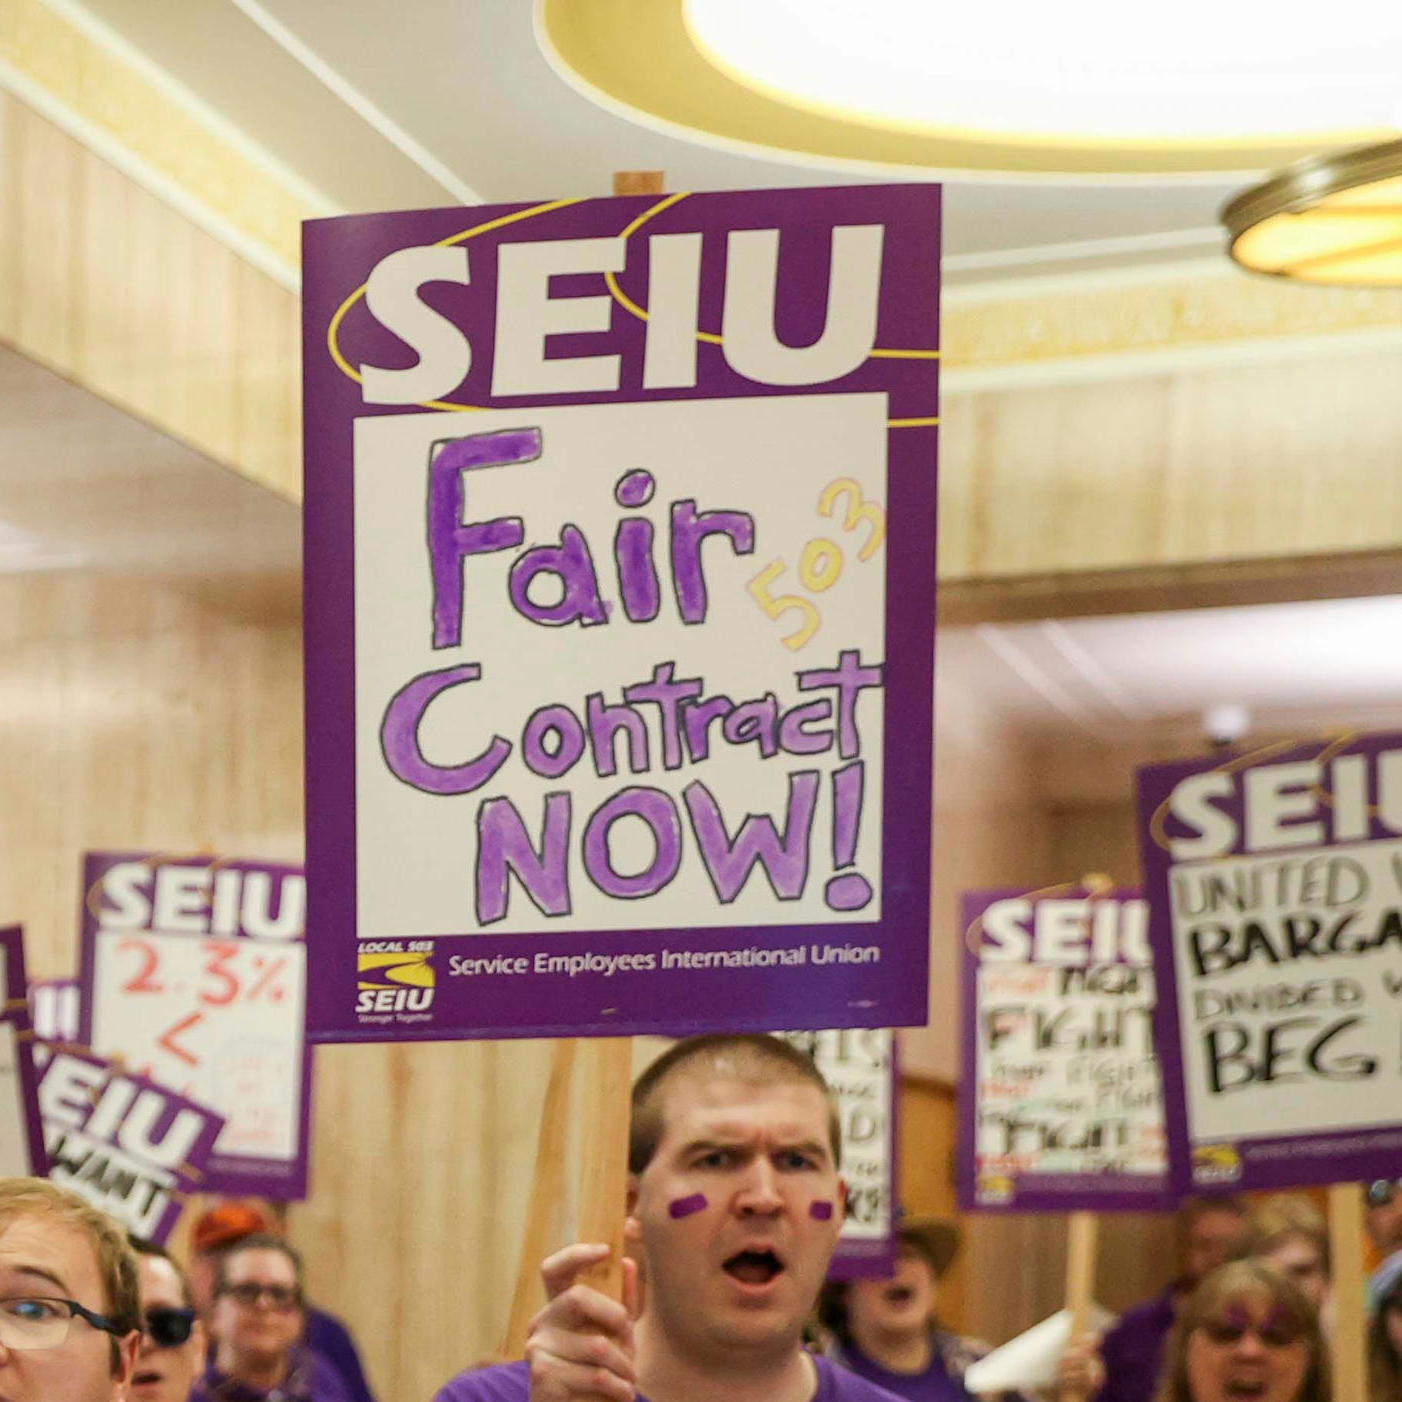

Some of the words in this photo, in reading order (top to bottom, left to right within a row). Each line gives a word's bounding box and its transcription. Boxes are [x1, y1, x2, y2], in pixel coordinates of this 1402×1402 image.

[359, 224, 885, 404] SEIU
[427, 427, 755, 649] Fair
[746, 475, 886, 652] 503
[380, 650, 886, 795] Contract
[475, 760, 873, 926] NOW!
[1177, 856, 1370, 915] UNITED
[98, 862, 306, 939] SEIU
[1188, 905, 1402, 977] BARGA
[355, 988, 435, 1012] SEIU
[448, 953, 528, 977] Service
[533, 950, 657, 978] Employees
[661, 946, 806, 970] International
[809, 943, 881, 966] Union
[33, 1043, 206, 1171] EIU
[1203, 1013, 1379, 1097] BEG
